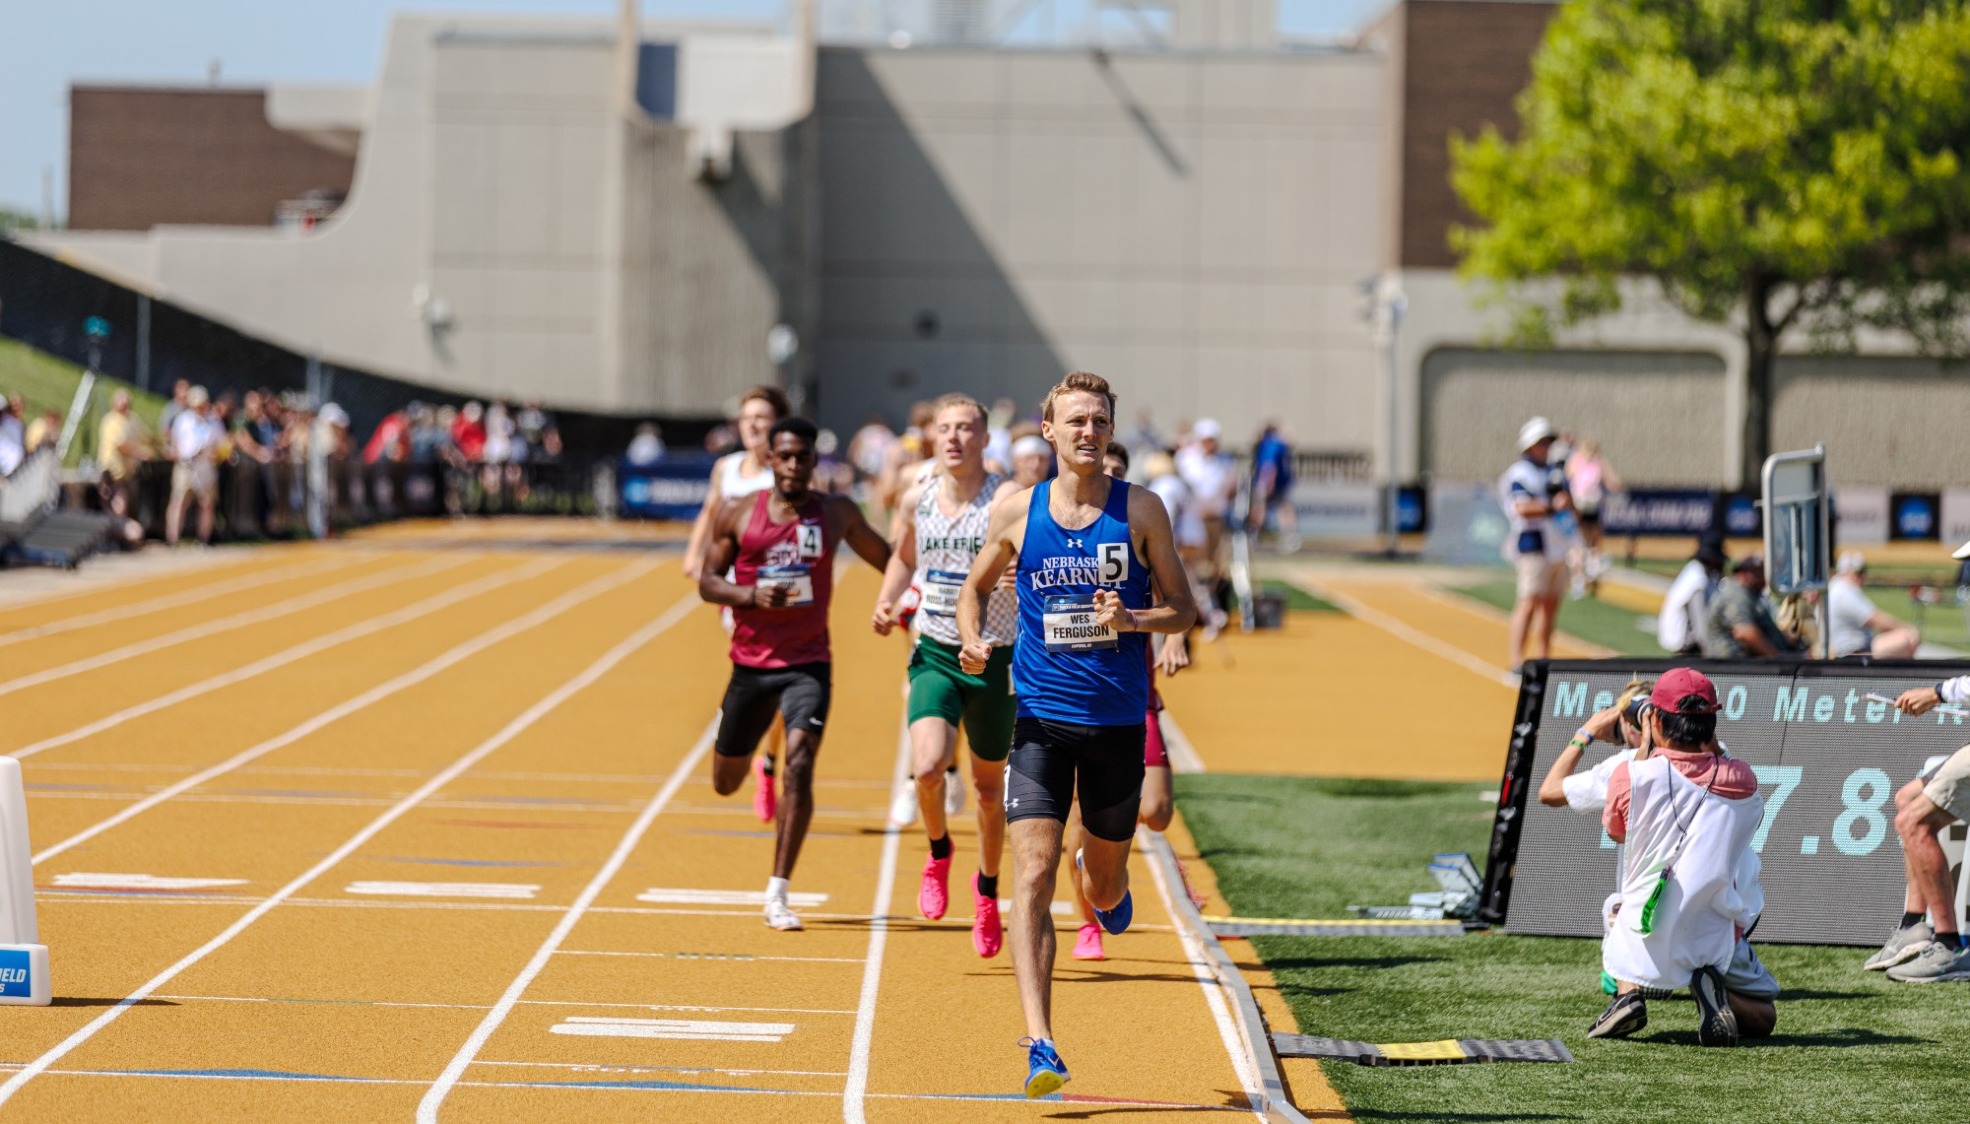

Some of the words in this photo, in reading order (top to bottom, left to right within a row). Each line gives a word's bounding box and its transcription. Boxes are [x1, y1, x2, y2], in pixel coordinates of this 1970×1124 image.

[803, 529, 816, 553] 4
[922, 537, 949, 554] LAKE
[1043, 556, 1099, 569] NEBRASK
[1105, 545, 1123, 581] 5
[1030, 567, 1122, 591] KEARN
[1070, 614, 1090, 624] WES
[1053, 625, 1109, 639] FERGUSON
